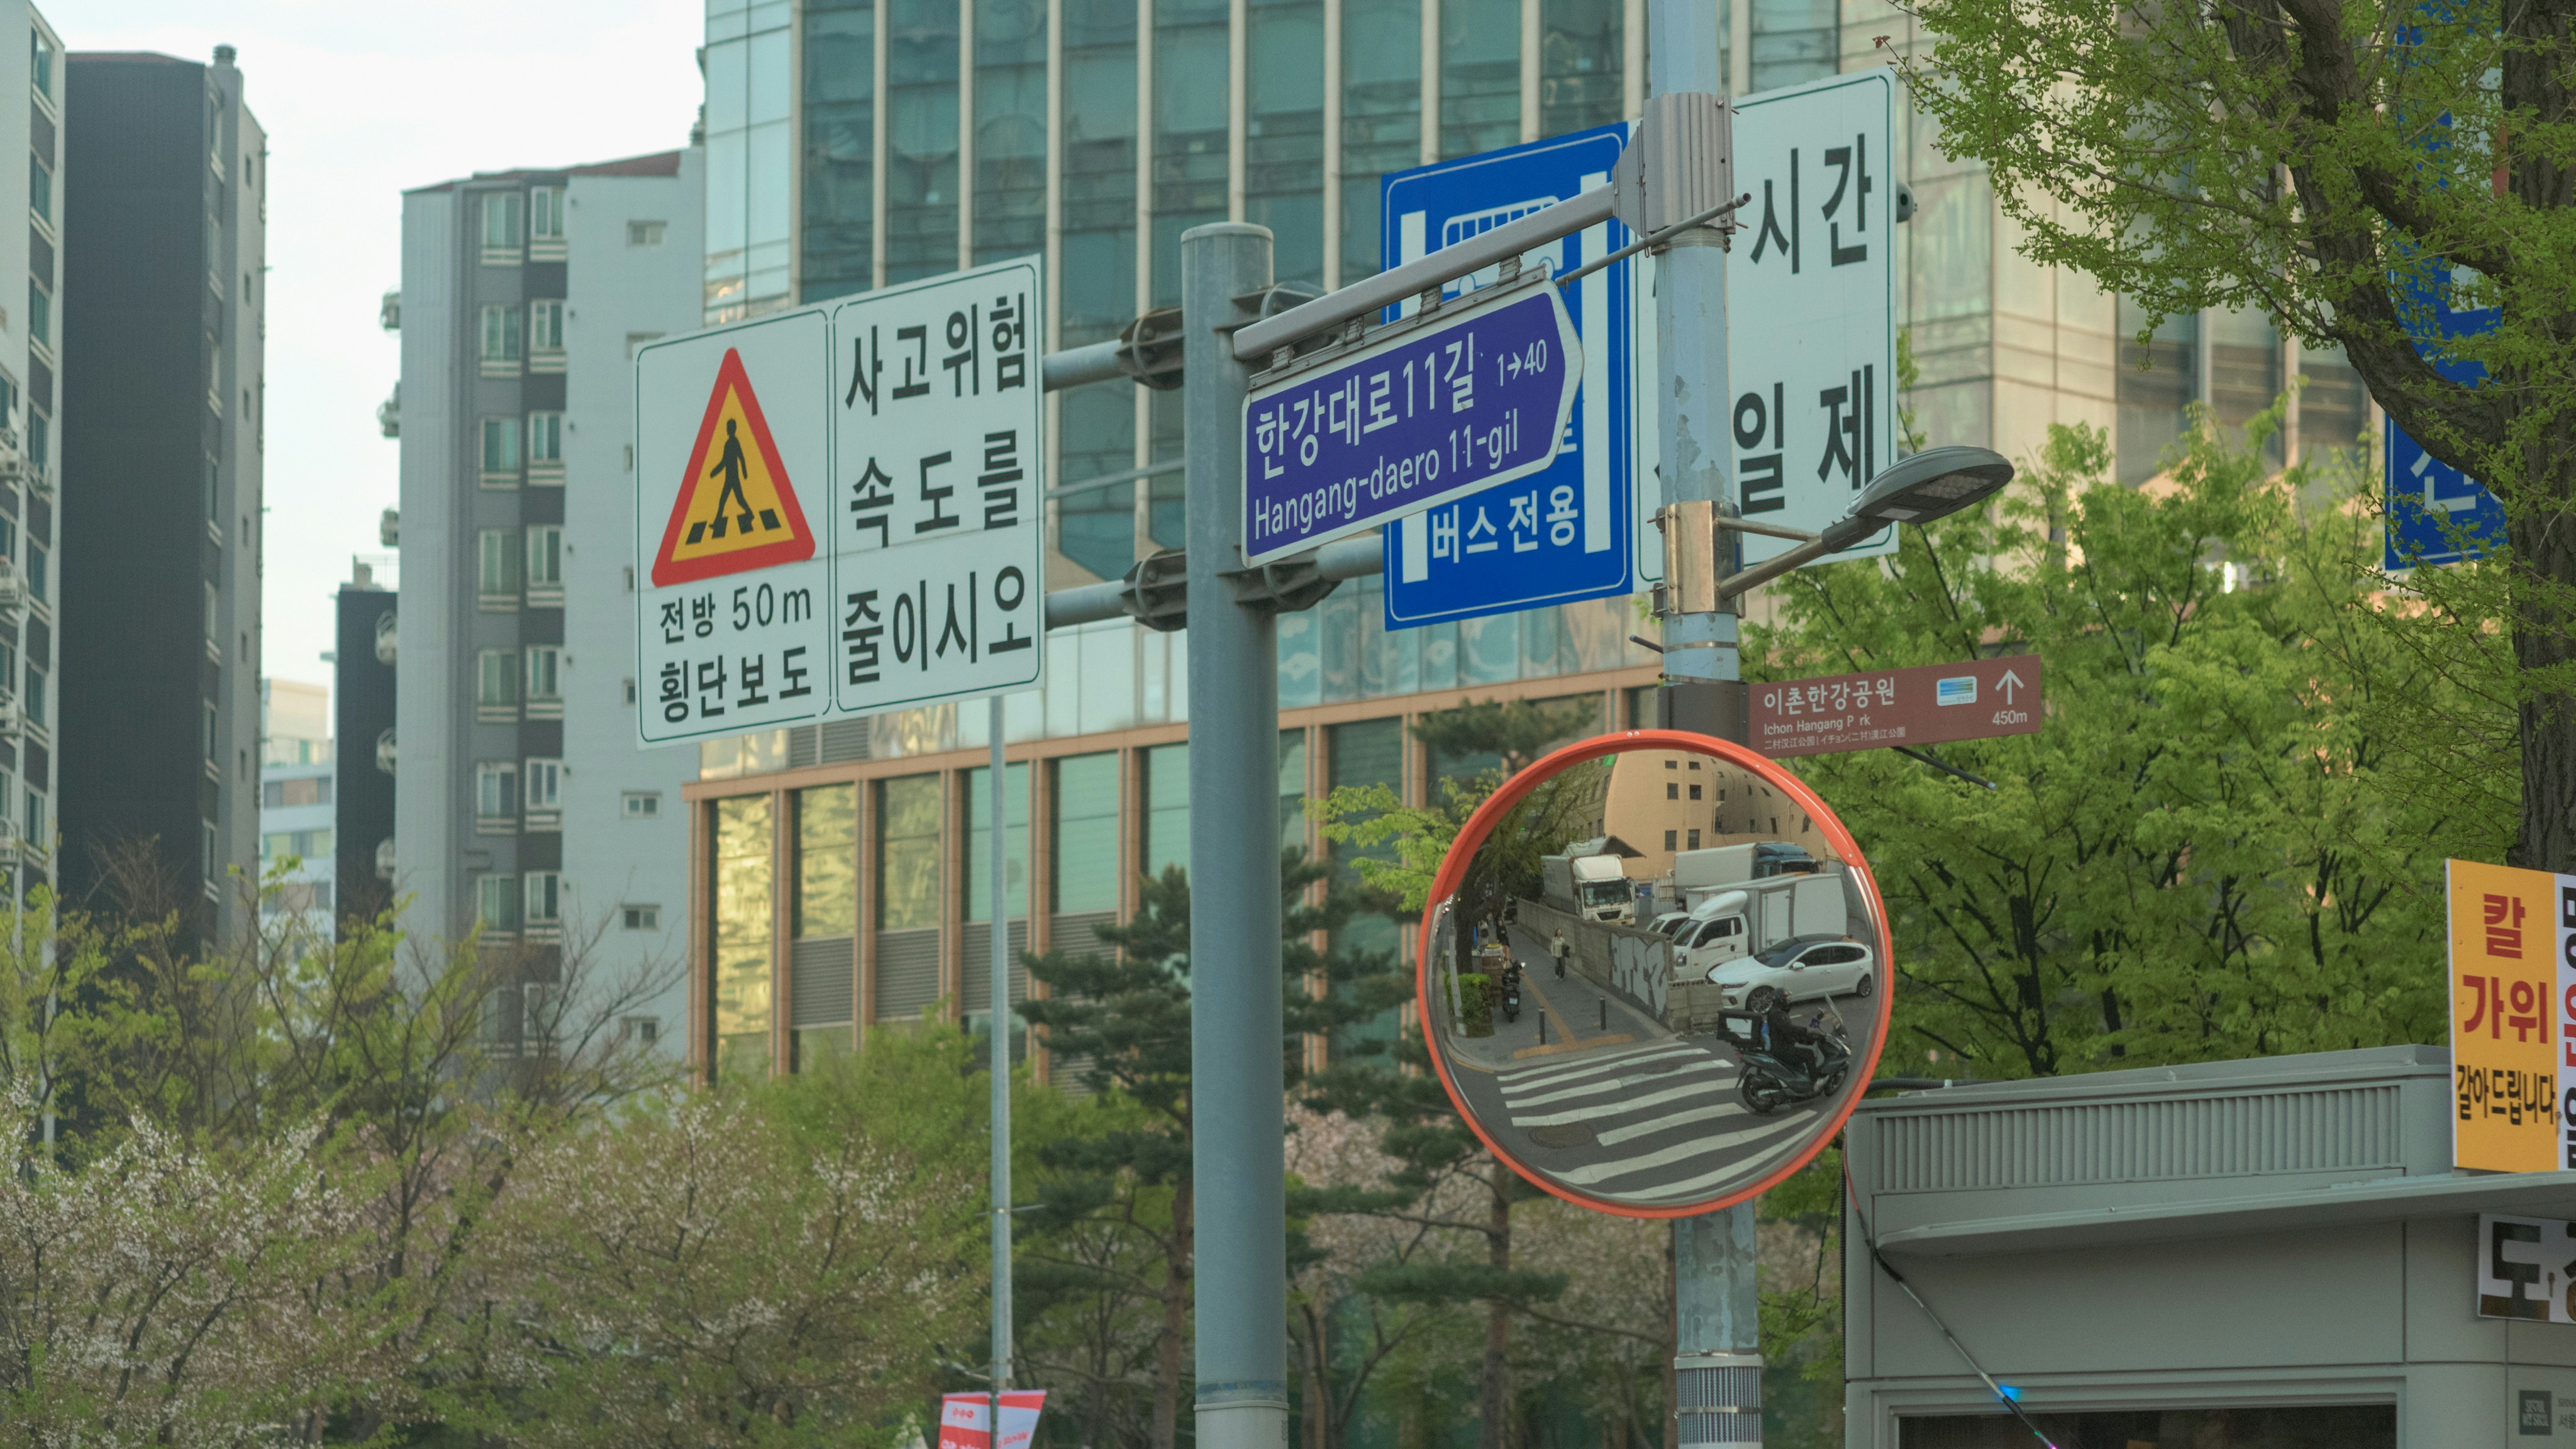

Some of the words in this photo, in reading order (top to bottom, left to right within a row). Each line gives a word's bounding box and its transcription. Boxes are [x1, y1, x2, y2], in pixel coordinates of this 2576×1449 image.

[845, 292, 1026, 416] 사고위험
[1256, 333, 1474, 480] 한강대로11길
[1654, 364, 1874, 515] 일제
[850, 430, 1023, 548] 속도를
[1255, 449, 1440, 540] Hangang-daero
[1449, 408, 1518, 473] 11-gil
[660, 592, 716, 645] 전방
[732, 582, 811, 632] 50m
[842, 565, 1031, 686] 줄이시오
[660, 646, 811, 723] 횡단보도
[1764, 677, 1894, 715] 이촌한강공원
[1992, 710, 2028, 725] 450m
[1764, 723, 1793, 735] Ichon
[1797, 719, 1843, 733] Hangang
[1847, 714, 1870, 727] Prk
[2484, 893, 2526, 960] 칼
[2462, 974, 2548, 1045] 가위
[2457, 1064, 2556, 1126] 갈아드립니다
[2480, 1221, 2576, 1323] 도
